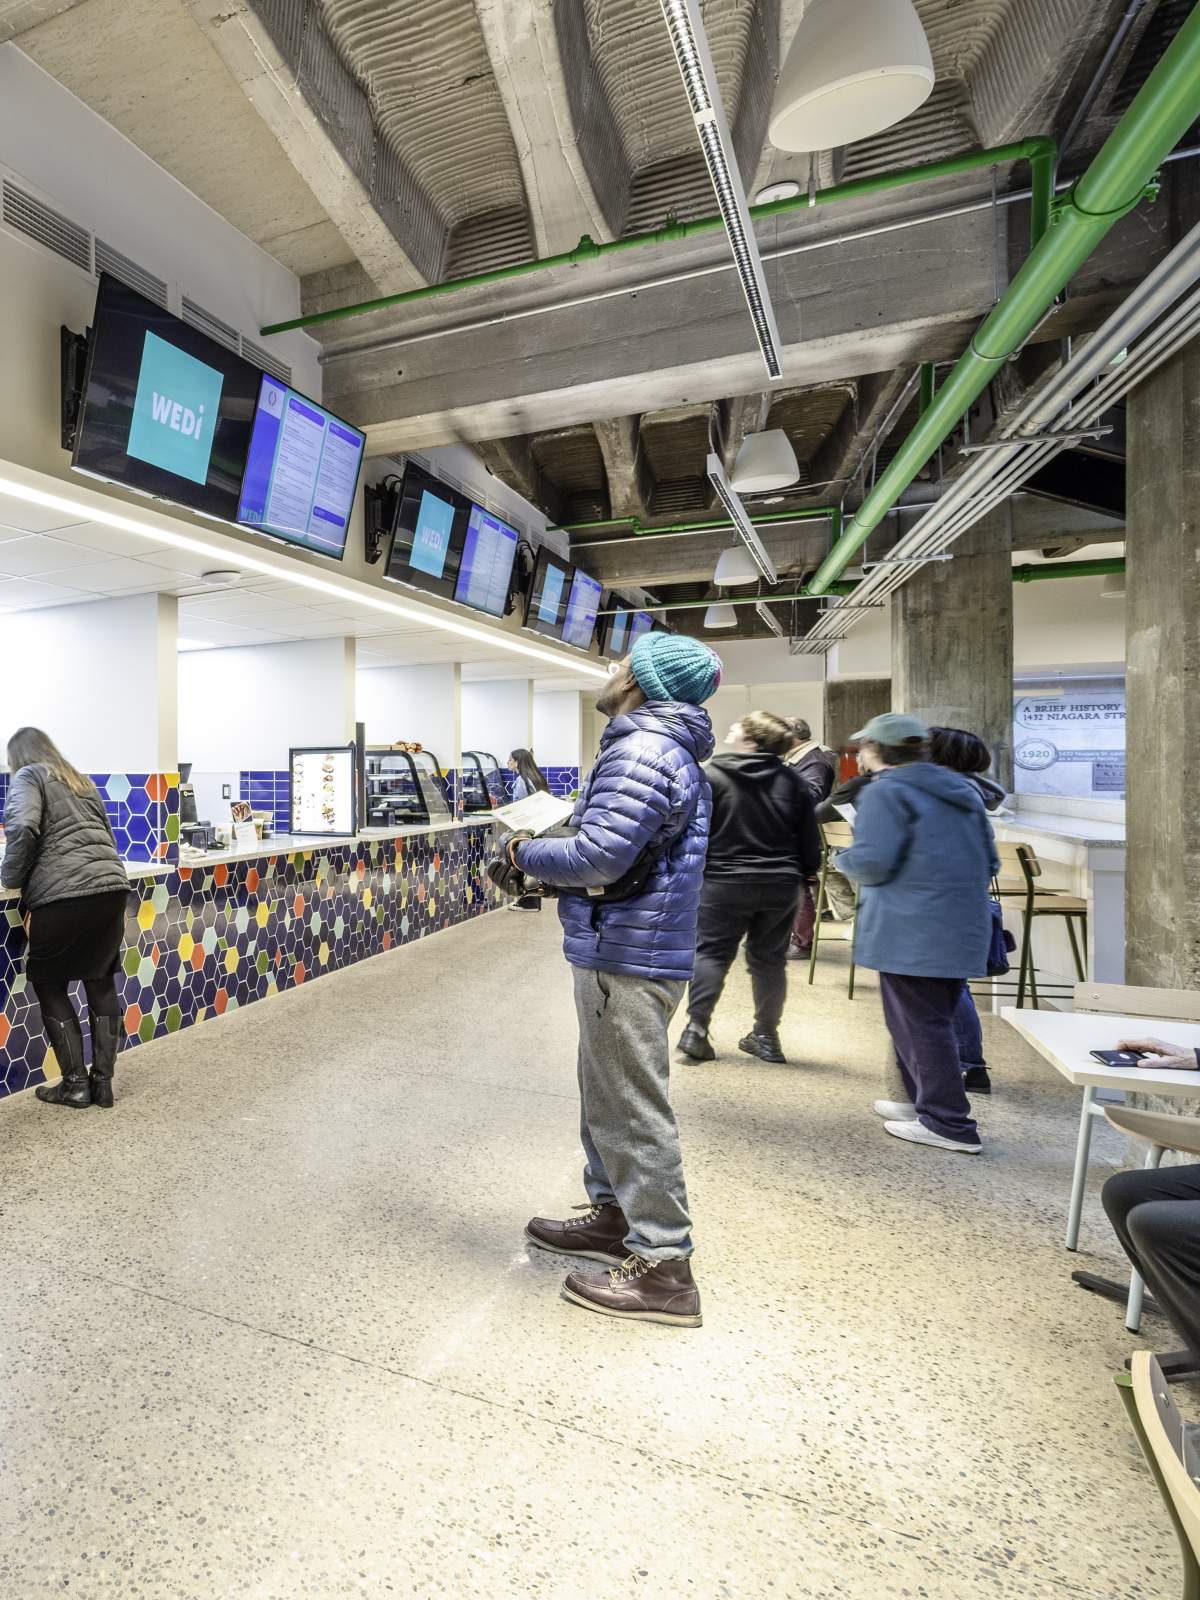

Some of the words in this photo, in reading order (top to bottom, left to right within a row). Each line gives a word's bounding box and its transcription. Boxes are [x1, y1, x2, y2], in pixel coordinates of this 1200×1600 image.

[152, 391, 204, 440] WEDi
[1070, 704, 1121, 712] HISTORY
[1022, 750, 1050, 758] 1920
